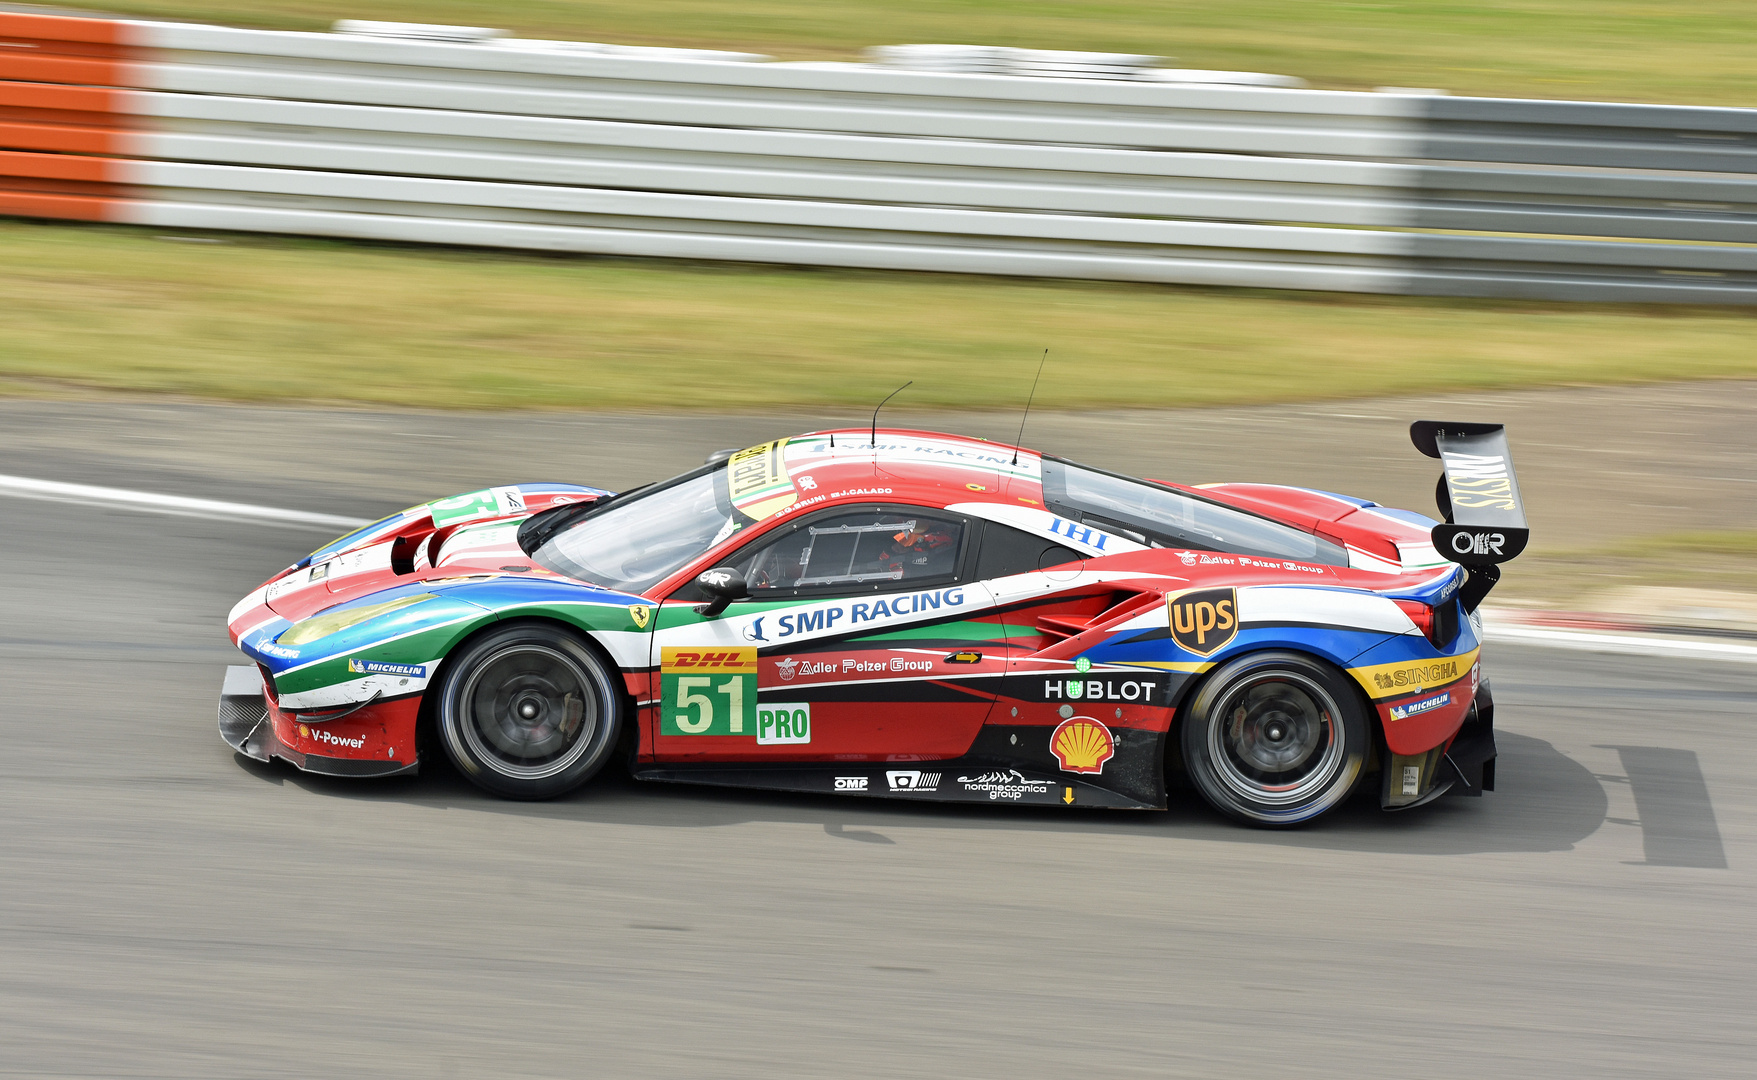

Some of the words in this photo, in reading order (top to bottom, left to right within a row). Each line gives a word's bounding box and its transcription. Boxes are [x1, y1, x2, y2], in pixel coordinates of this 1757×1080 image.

[914, 446, 1030, 469] RACING
[839, 488, 893, 497] J.CALADO
[432, 490, 499, 526] 51
[1047, 516, 1110, 551] IHI
[1199, 554, 1235, 565] Adler
[1238, 557, 1281, 569] Pelzer
[1283, 561, 1324, 574] Group
[778, 607, 844, 637] SMP
[851, 588, 964, 624] RACING
[1173, 599, 1234, 645] ups
[367, 663, 423, 675] MICHELIN
[673, 652, 746, 668] DHL
[798, 660, 838, 676] Adler
[842, 659, 887, 674] Pelzer
[889, 657, 933, 672] Group
[1393, 661, 1458, 687] SINGHA
[1045, 680, 1156, 702] HUBLOT
[675, 675, 743, 734] 51
[1408, 693, 1448, 713] MICHELIN
[758, 708, 808, 739] PRO
[311, 728, 366, 749] V-Power
[834, 778, 868, 790] OMP
[964, 782, 1047, 794] nordmeccanica
[989, 790, 1022, 801] group
